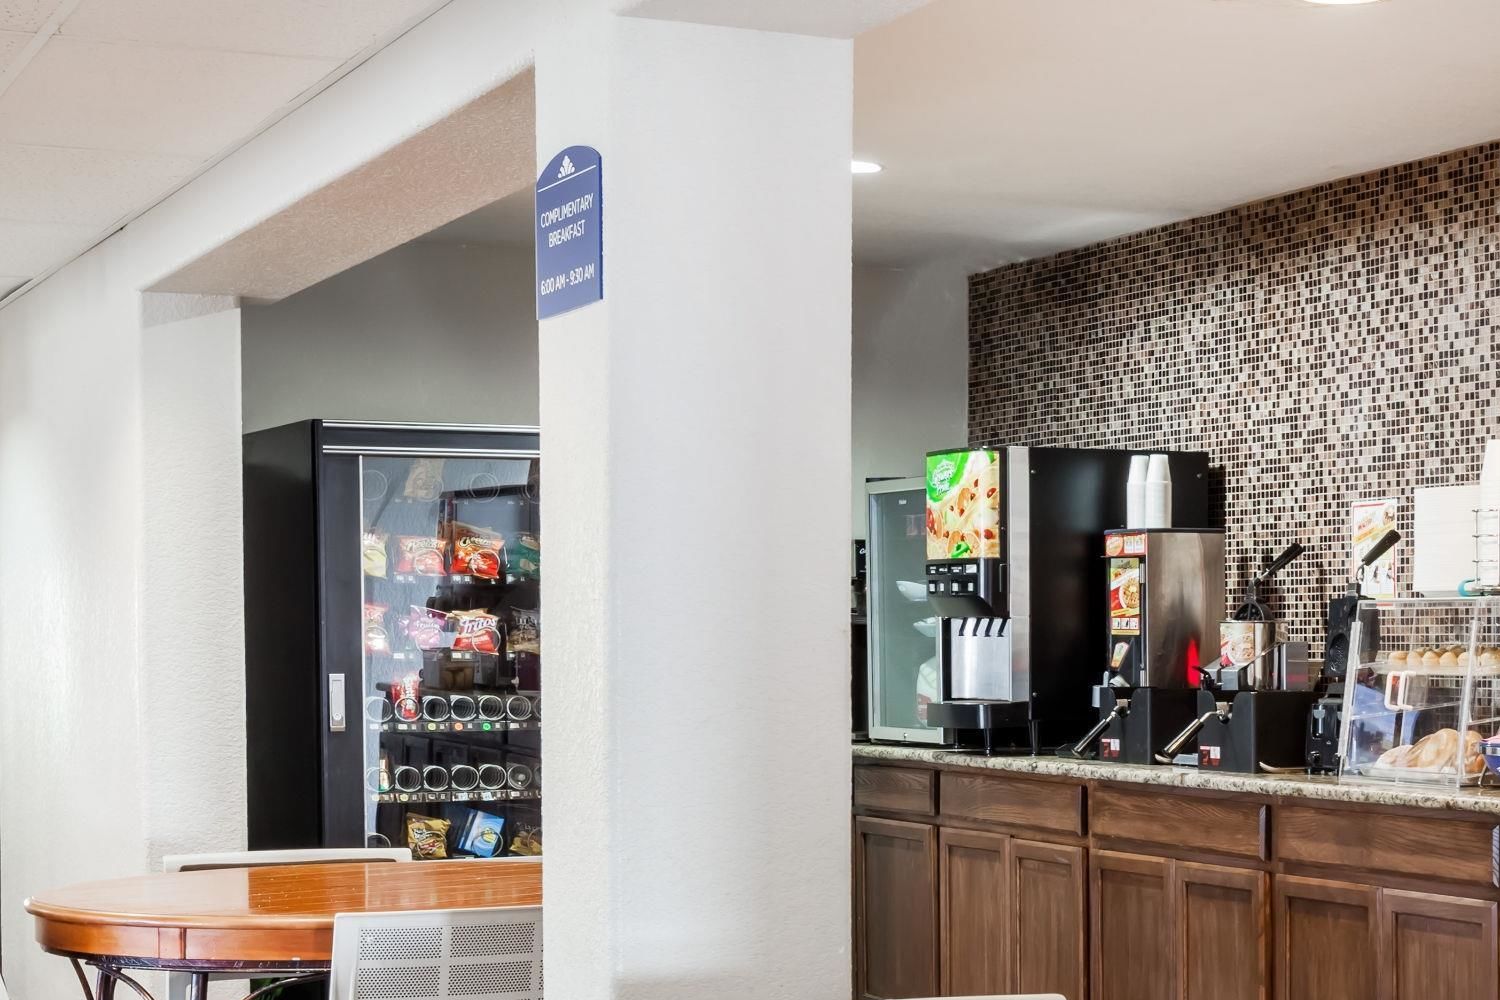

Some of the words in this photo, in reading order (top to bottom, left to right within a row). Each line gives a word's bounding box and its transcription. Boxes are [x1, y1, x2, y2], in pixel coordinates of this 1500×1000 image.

[540, 193, 594, 228] COMPLIMENTARY
[548, 219, 586, 248] BREAKFAST
[541, 278, 555, 296] 6:00
[555, 274, 566, 291] AM
[570, 267, 584, 286] 9:30
[584, 263, 595, 281] AM
[460, 616, 498, 634] Fritos
